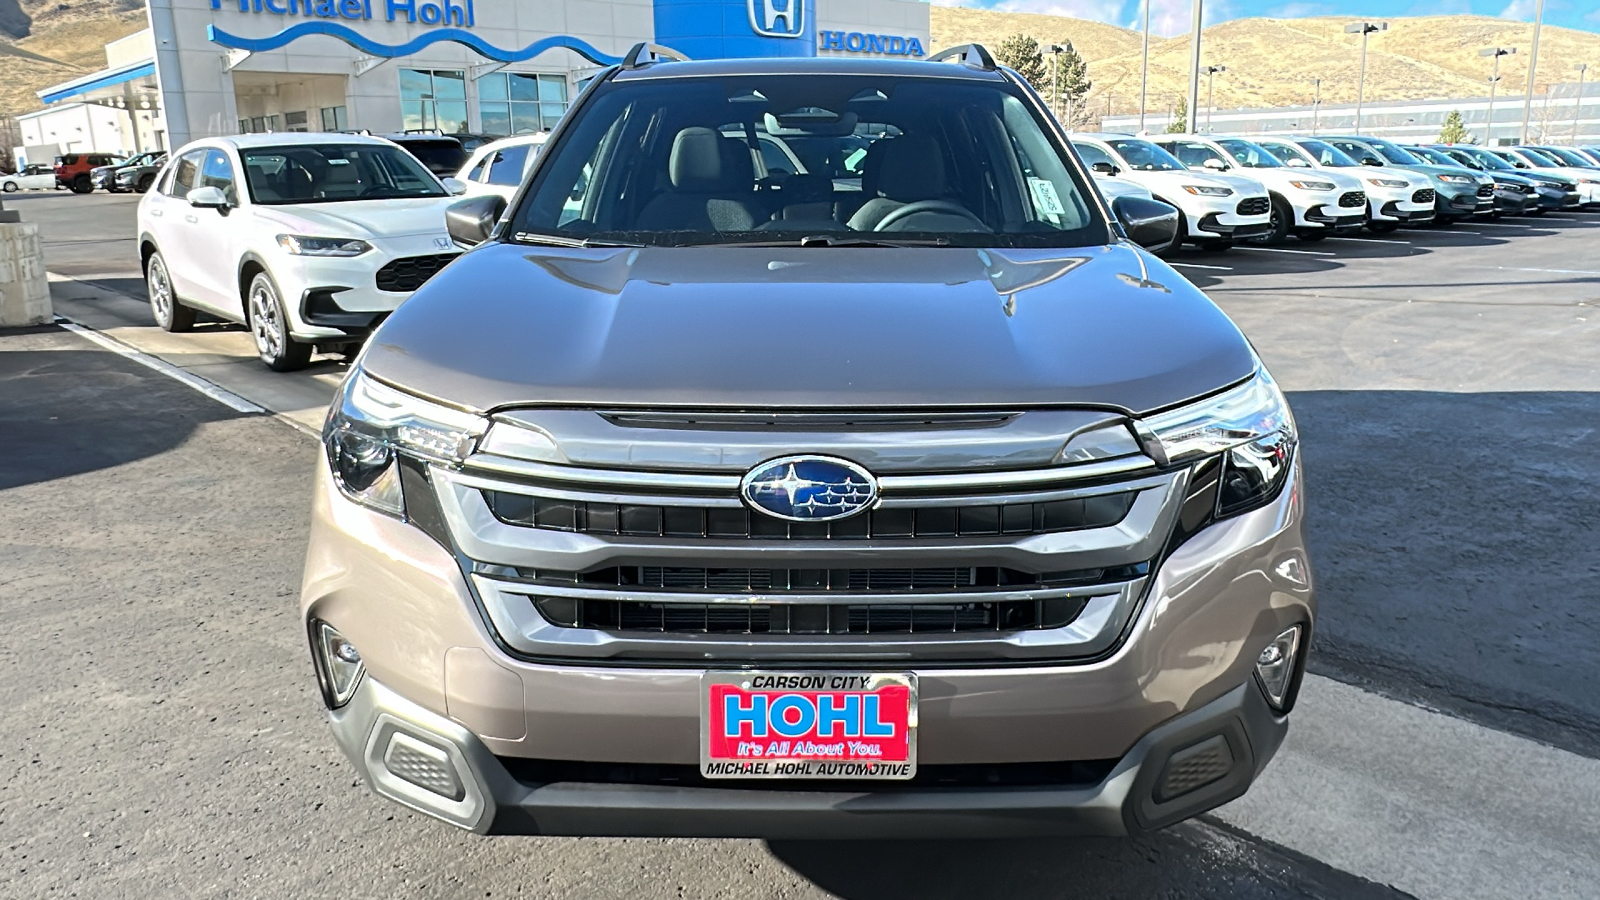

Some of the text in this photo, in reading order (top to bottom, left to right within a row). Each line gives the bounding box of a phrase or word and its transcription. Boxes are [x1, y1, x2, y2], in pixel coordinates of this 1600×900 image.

[385, 0, 475, 27] Hohl
[819, 30, 926, 56] HONDA
[752, 676, 870, 689] CARSON CITY
[723, 694, 895, 737] HOHL
[737, 740, 882, 756] It's All About You.
[706, 762, 911, 776] MICHAEL HOHL AUTOMOTIVE
